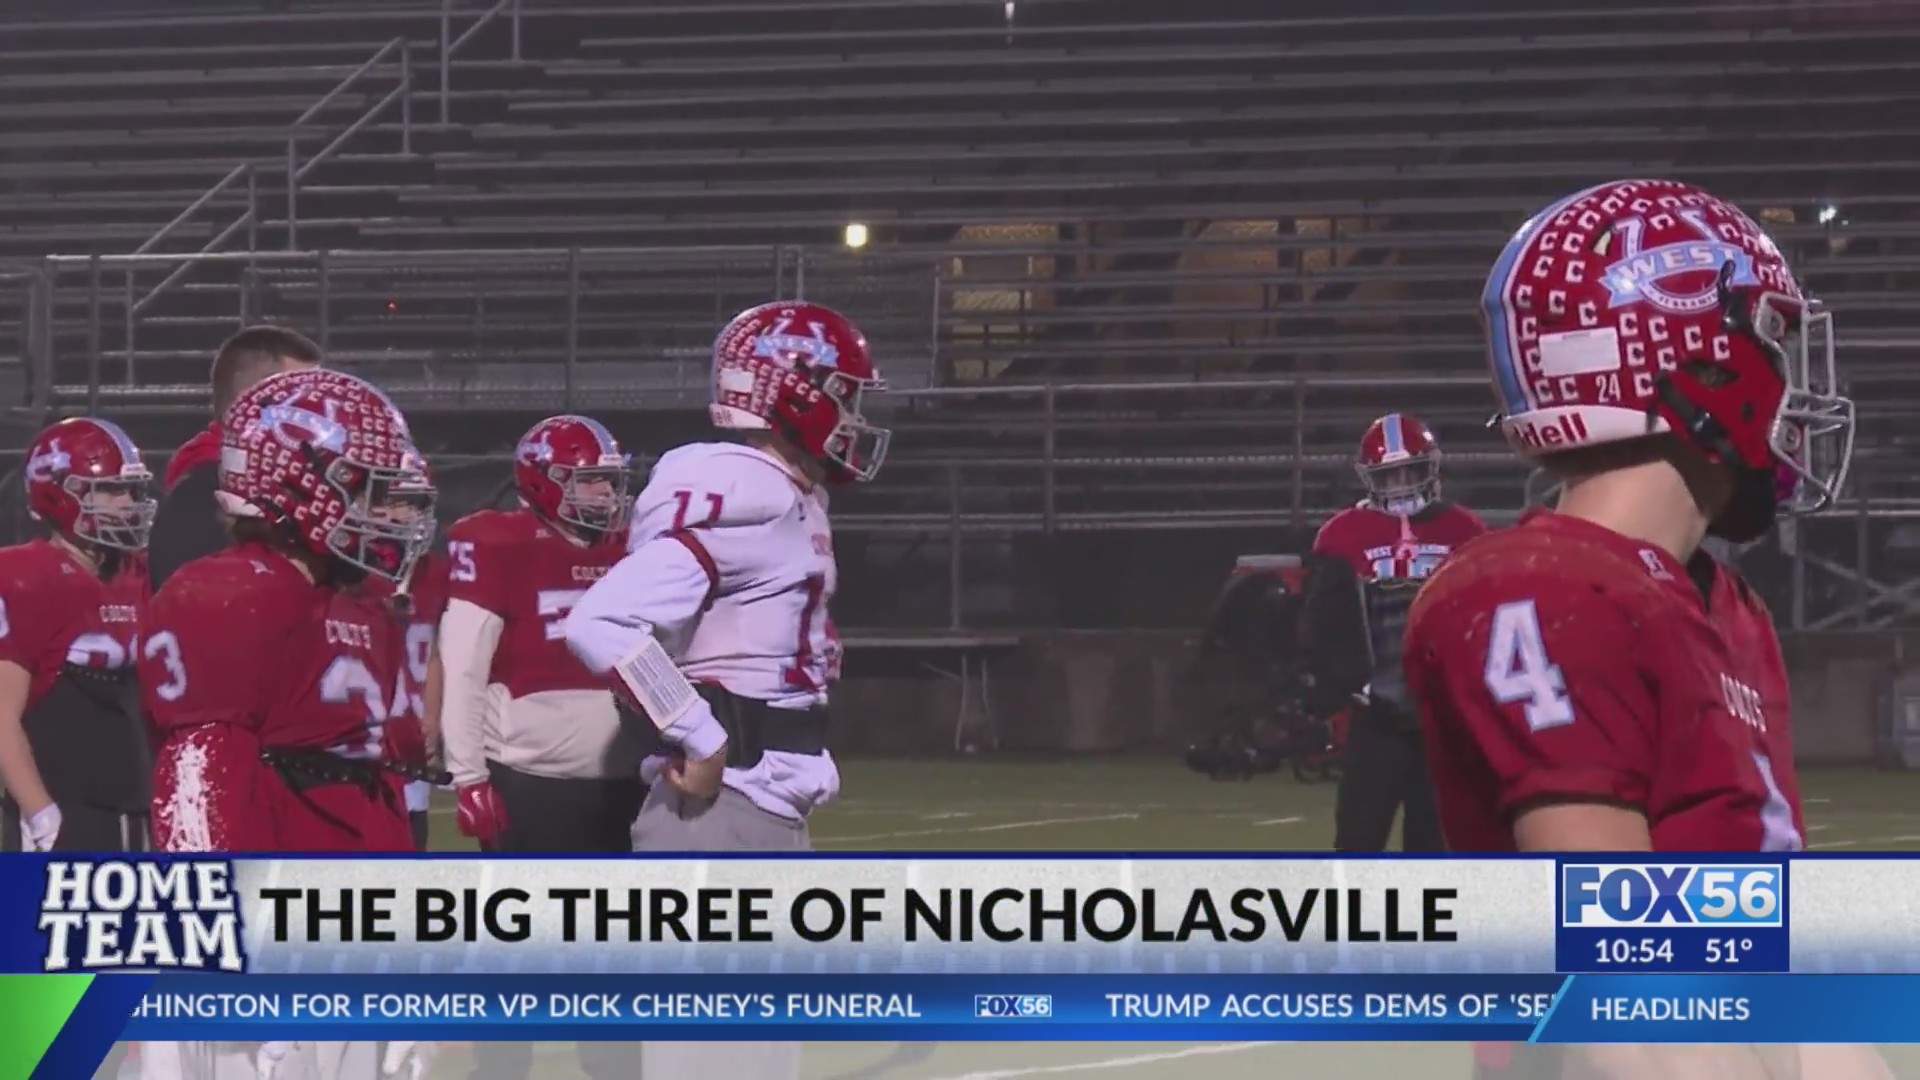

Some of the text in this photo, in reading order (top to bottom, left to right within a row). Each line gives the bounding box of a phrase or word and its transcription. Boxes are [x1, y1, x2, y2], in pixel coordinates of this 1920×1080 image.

[1616, 246, 1736, 281] WEST
[1595, 373, 1621, 403] 24
[570, 565, 608, 580] COLT
[143, 630, 187, 702] 3
[1484, 599, 1576, 733] 4
